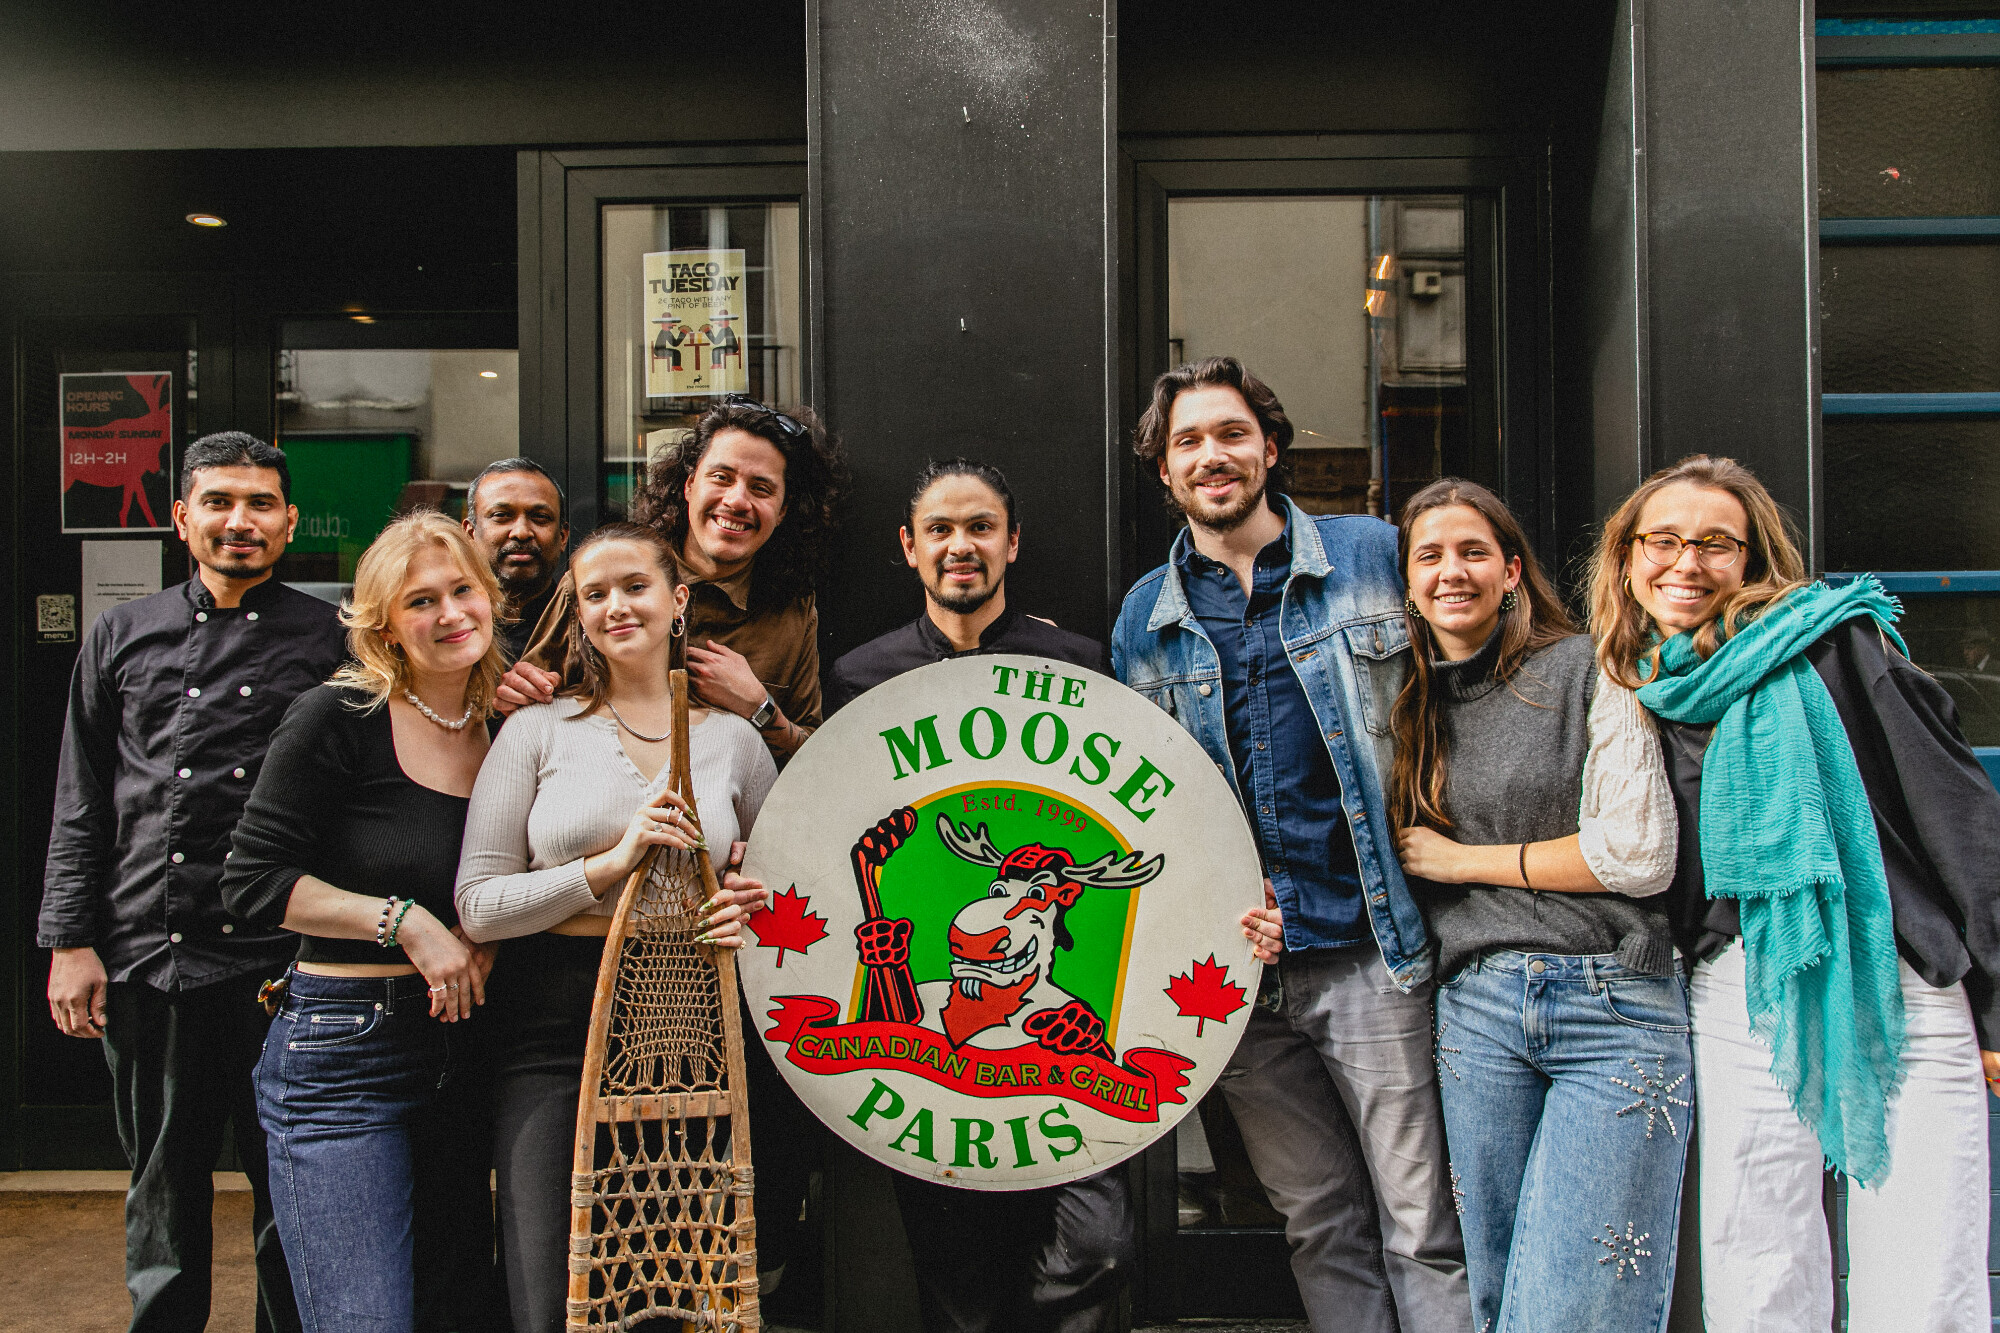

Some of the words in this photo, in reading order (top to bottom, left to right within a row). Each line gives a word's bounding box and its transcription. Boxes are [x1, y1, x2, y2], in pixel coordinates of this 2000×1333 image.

[667, 262, 720, 278] TACO
[648, 276, 740, 294] TUESDAY
[667, 302, 686, 310] PINT
[702, 301, 725, 309] BEER
[670, 296, 692, 304] TACO
[714, 294, 732, 302] ANY
[66, 391, 123, 401] OPENING
[66, 402, 111, 413] HOURS
[69, 452, 127, 465] 12H-2H
[992, 664, 1087, 708] THE
[879, 706, 1176, 823] MOOSE
[961, 794, 1023, 813] Estd.
[1035, 799, 1088, 834] 1999
[795, 1034, 971, 1079] CANADIAN
[974, 1061, 1041, 1087] BAR
[1047, 1064, 1065, 1085] &
[1069, 1065, 1151, 1112] GRILL
[846, 1076, 1083, 1169] PARIS
